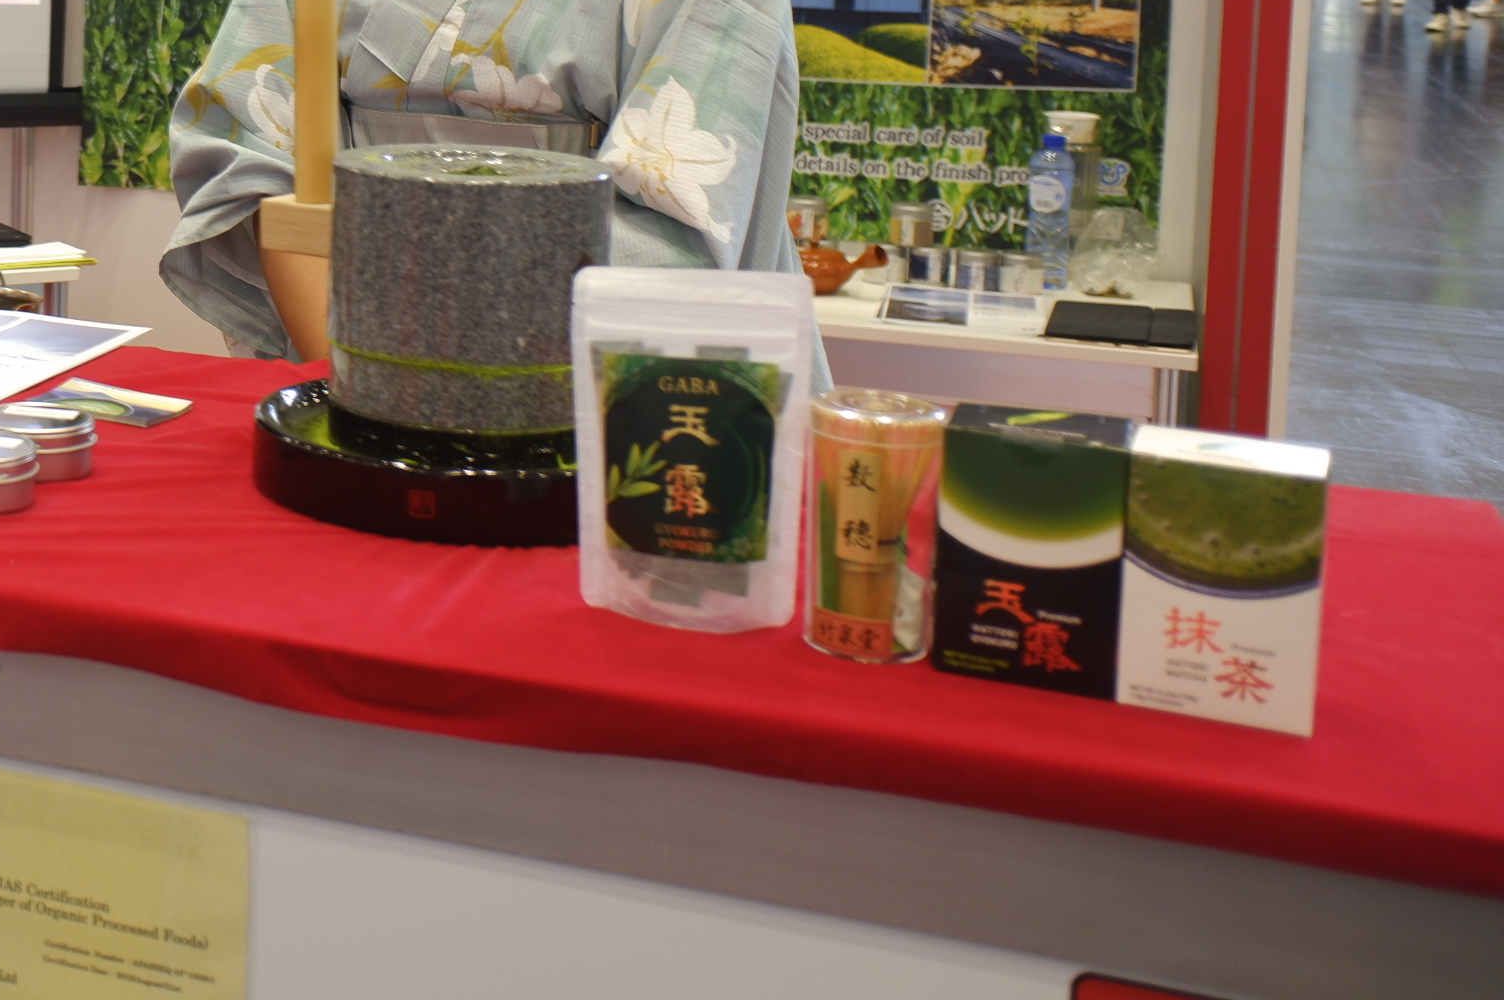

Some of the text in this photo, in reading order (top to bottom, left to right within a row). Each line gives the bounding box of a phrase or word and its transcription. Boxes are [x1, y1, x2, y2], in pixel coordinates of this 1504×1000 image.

[804, 122, 984, 147] special care of soil
[796, 154, 857, 174] details
[864, 161, 887, 175] on
[896, 158, 926, 177] the
[932, 161, 989, 181] finish
[658, 376, 720, 396] GABA
[661, 403, 721, 518] 玉露
[976, 578, 1082, 672] 玉露
[1164, 606, 1276, 704] 抹茶
[26, 883, 110, 913] Certification
[18, 898, 32, 912] of
[35, 901, 88, 925] Organic
[92, 913, 159, 940] Processed
